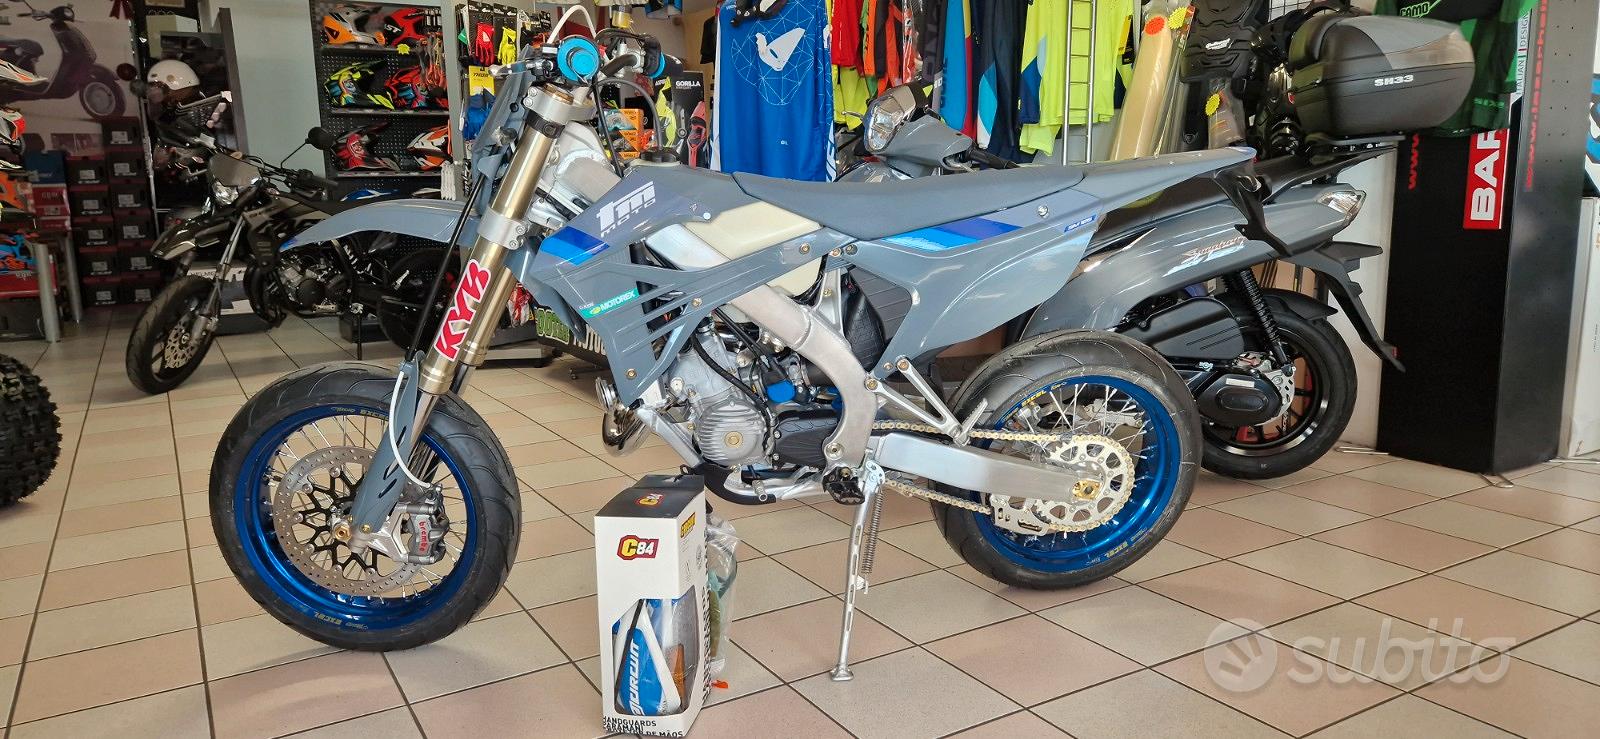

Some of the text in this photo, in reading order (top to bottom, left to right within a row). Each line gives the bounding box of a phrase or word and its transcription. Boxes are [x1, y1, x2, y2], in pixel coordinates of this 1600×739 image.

[1374, 75, 1414, 86] SH33
[434, 259, 491, 362] KYB
[600, 290, 636, 311] MOTOREX
[419, 521, 429, 552] brembo
[620, 538, 656, 558] C84
